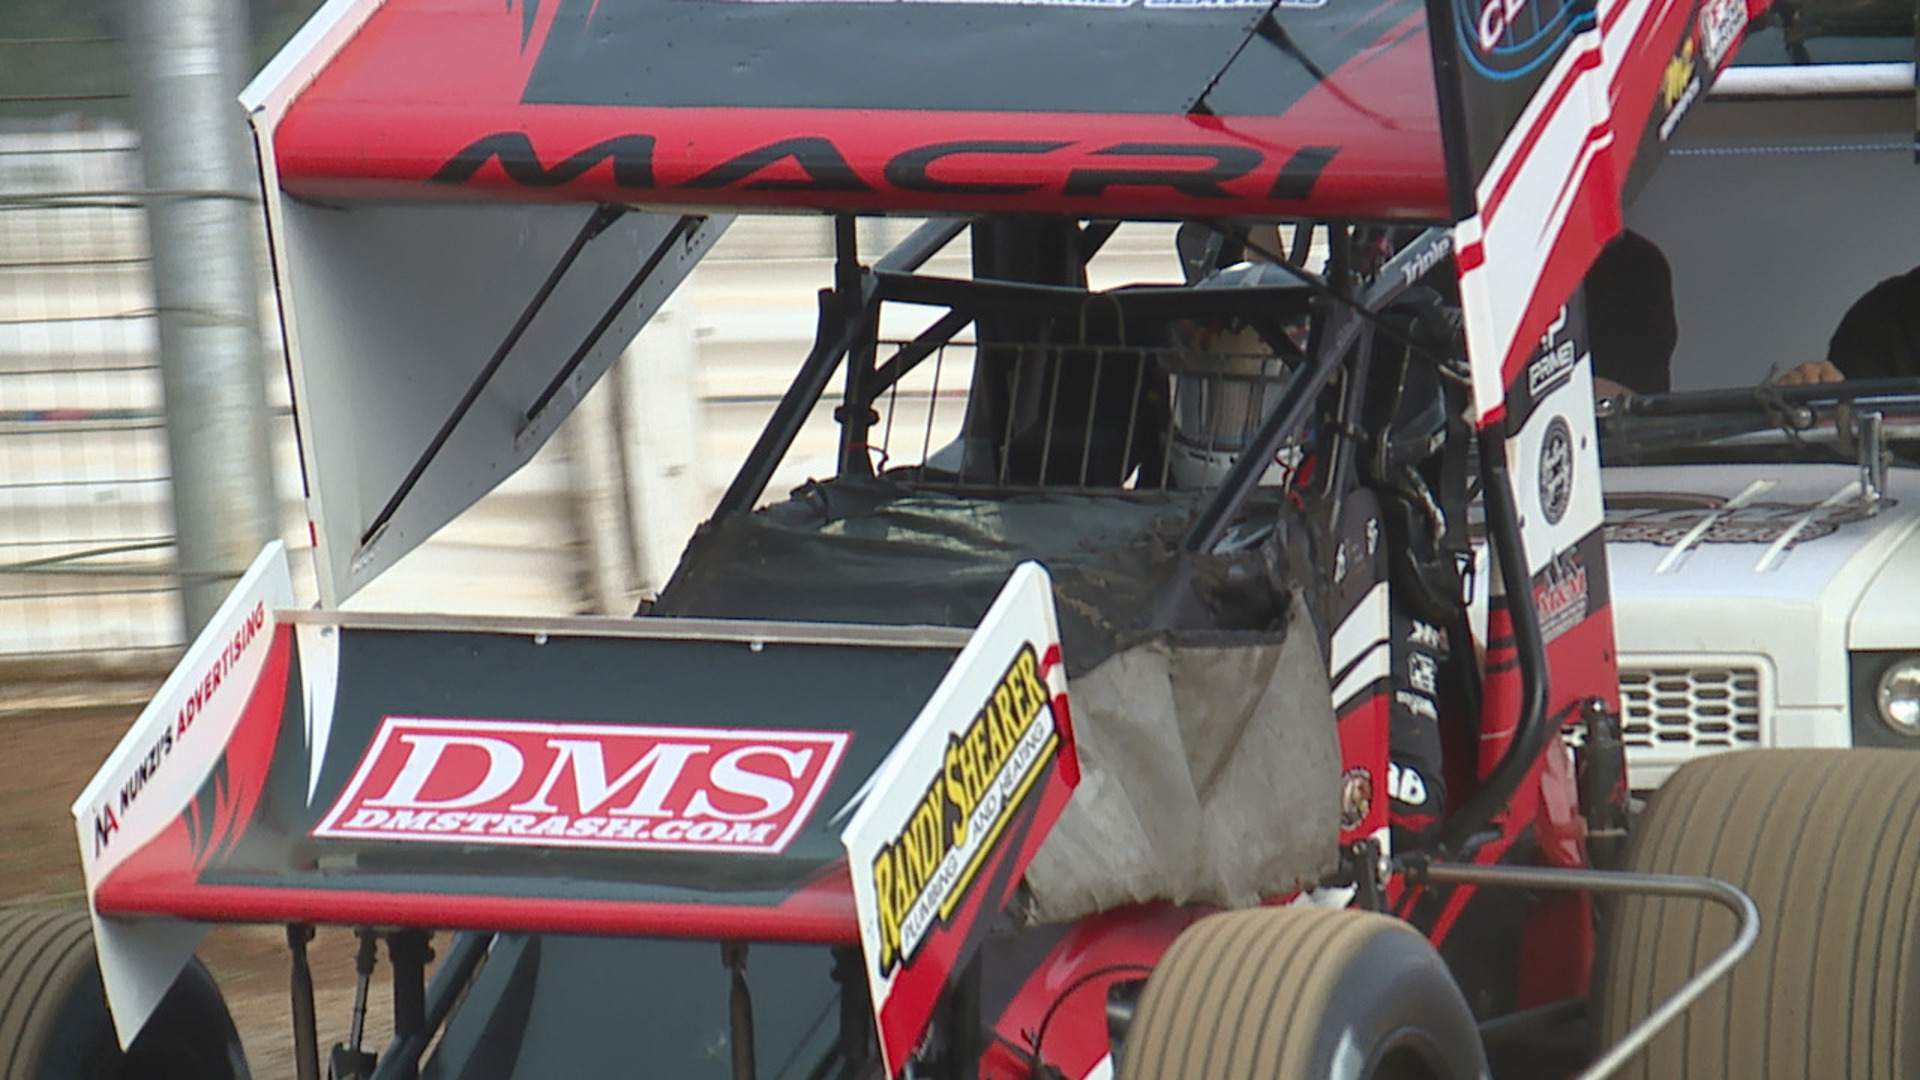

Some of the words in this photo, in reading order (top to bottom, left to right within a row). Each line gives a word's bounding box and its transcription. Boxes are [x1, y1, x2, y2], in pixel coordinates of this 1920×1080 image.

[427, 131, 1341, 200] MACRI
[119, 726, 174, 816] NUNZI'S
[175, 600, 265, 741] ADVERTISING
[363, 732, 815, 823] DMS
[342, 808, 777, 843] DMSTRASH.COM
[873, 776, 946, 968] RANDY
[944, 646, 1048, 848] SHEARER
[902, 853, 959, 947] PLUMBING
[972, 792, 998, 844] AND
[998, 720, 1045, 797] HEATING
